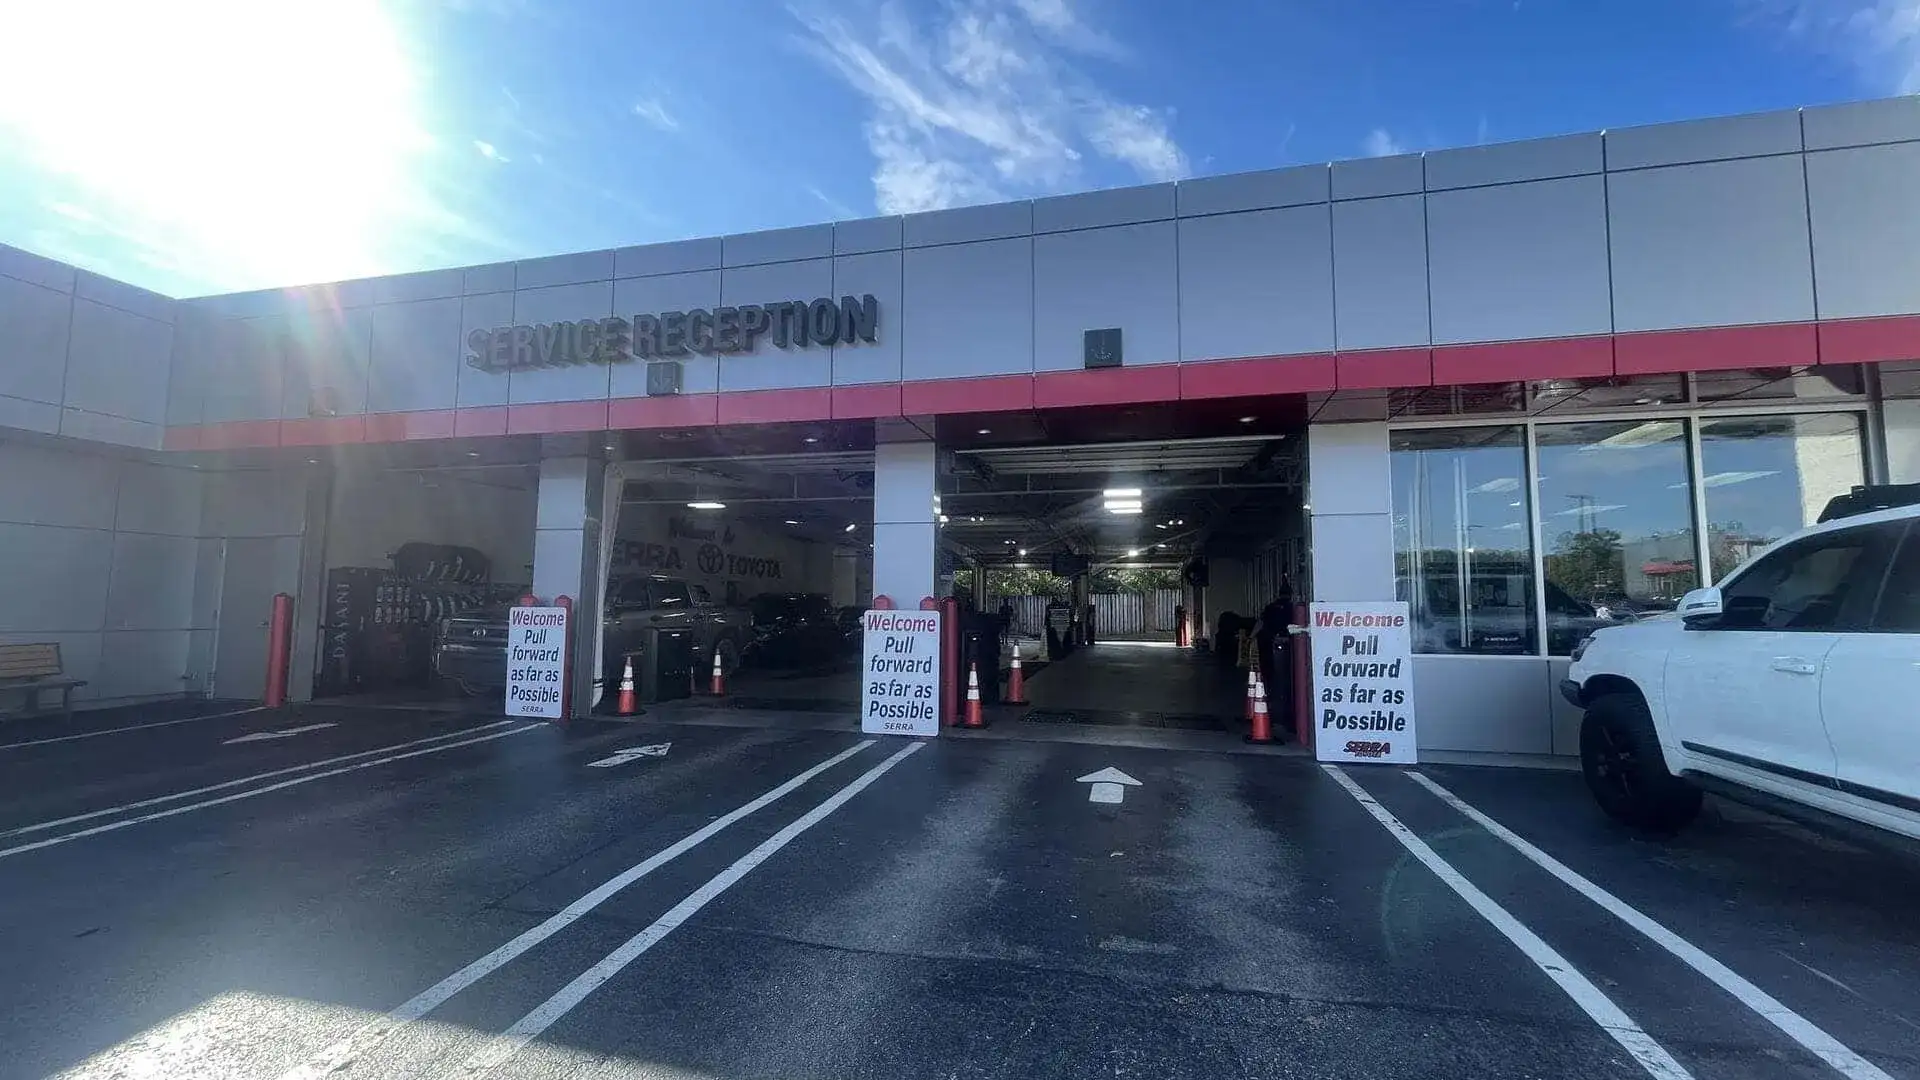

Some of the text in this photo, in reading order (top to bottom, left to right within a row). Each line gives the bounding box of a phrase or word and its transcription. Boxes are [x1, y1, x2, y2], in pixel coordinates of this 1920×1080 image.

[466, 294, 880, 374] SERVICE RECEPTION
[727, 554, 783, 579] TOYOTA
[331, 583, 350, 658] DASANI
[512, 610, 564, 626] Welcome
[868, 614, 936, 632] Welcome
[1315, 612, 1404, 627] Welcome
[525, 629, 547, 644] Pull
[885, 636, 914, 653] Pull
[1342, 635, 1378, 655] Pull
[512, 645, 559, 661] forward
[871, 655, 932, 673] forward
[1323, 657, 1401, 678] forward
[511, 666, 559, 682] as far as
[511, 685, 559, 703] Possible
[870, 679, 932, 698] as far as
[1322, 683, 1405, 704] as far as
[521, 705, 544, 713] SERRA
[869, 701, 933, 719] Possible
[884, 722, 913, 730] SERRA
[1322, 709, 1406, 731] Possible
[1343, 741, 1390, 754] SERRA
